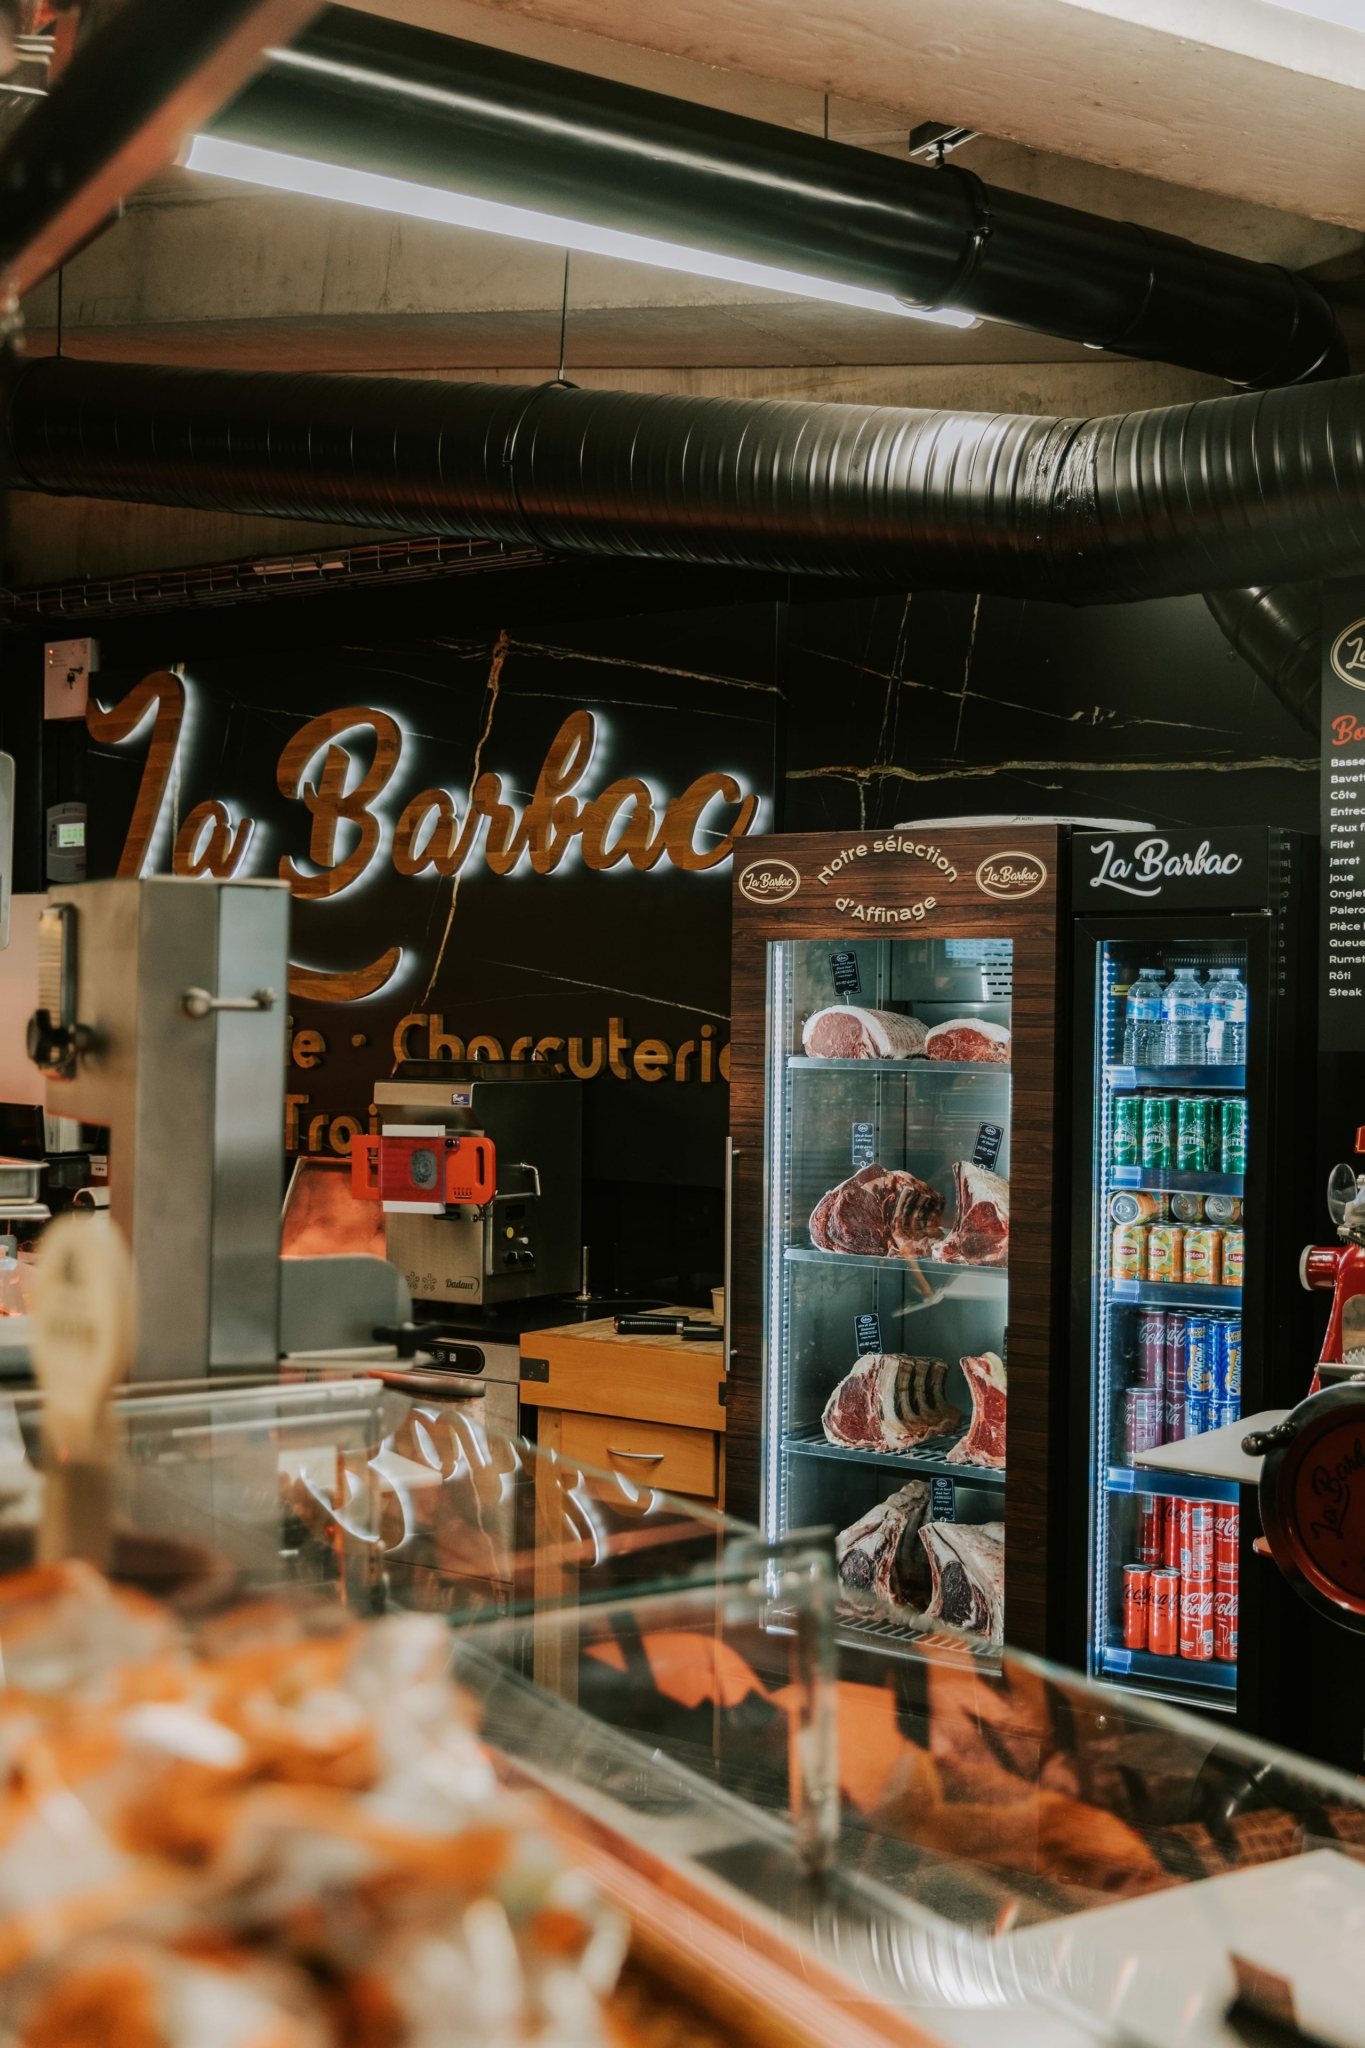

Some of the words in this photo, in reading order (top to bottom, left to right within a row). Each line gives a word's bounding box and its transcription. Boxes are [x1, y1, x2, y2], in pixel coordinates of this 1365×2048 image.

[86, 671, 255, 879] La
[277, 707, 758, 900] Barbac
[1330, 790, 1358, 801] Côte
[1330, 824, 1358, 833] Faux
[1330, 840, 1355, 850] Filet
[817, 843, 868, 886] Notre
[873, 835, 959, 884] sélection
[1329, 857, 1360, 868] Jarret
[1089, 840, 1162, 898] La
[1134, 838, 1243, 883] Barbac
[1000, 866, 1039, 883] Barbac
[1329, 873, 1355, 884] Joue
[760, 872, 794, 889] Barbac
[1329, 889, 1365, 900] Onglet
[1329, 921, 1361, 931] Pièce
[1329, 939, 1365, 948] Queue
[1328, 970, 1351, 980] Rôti
[1328, 987, 1363, 997] Steak
[1189, 1343, 1207, 1392] ORANGINA
